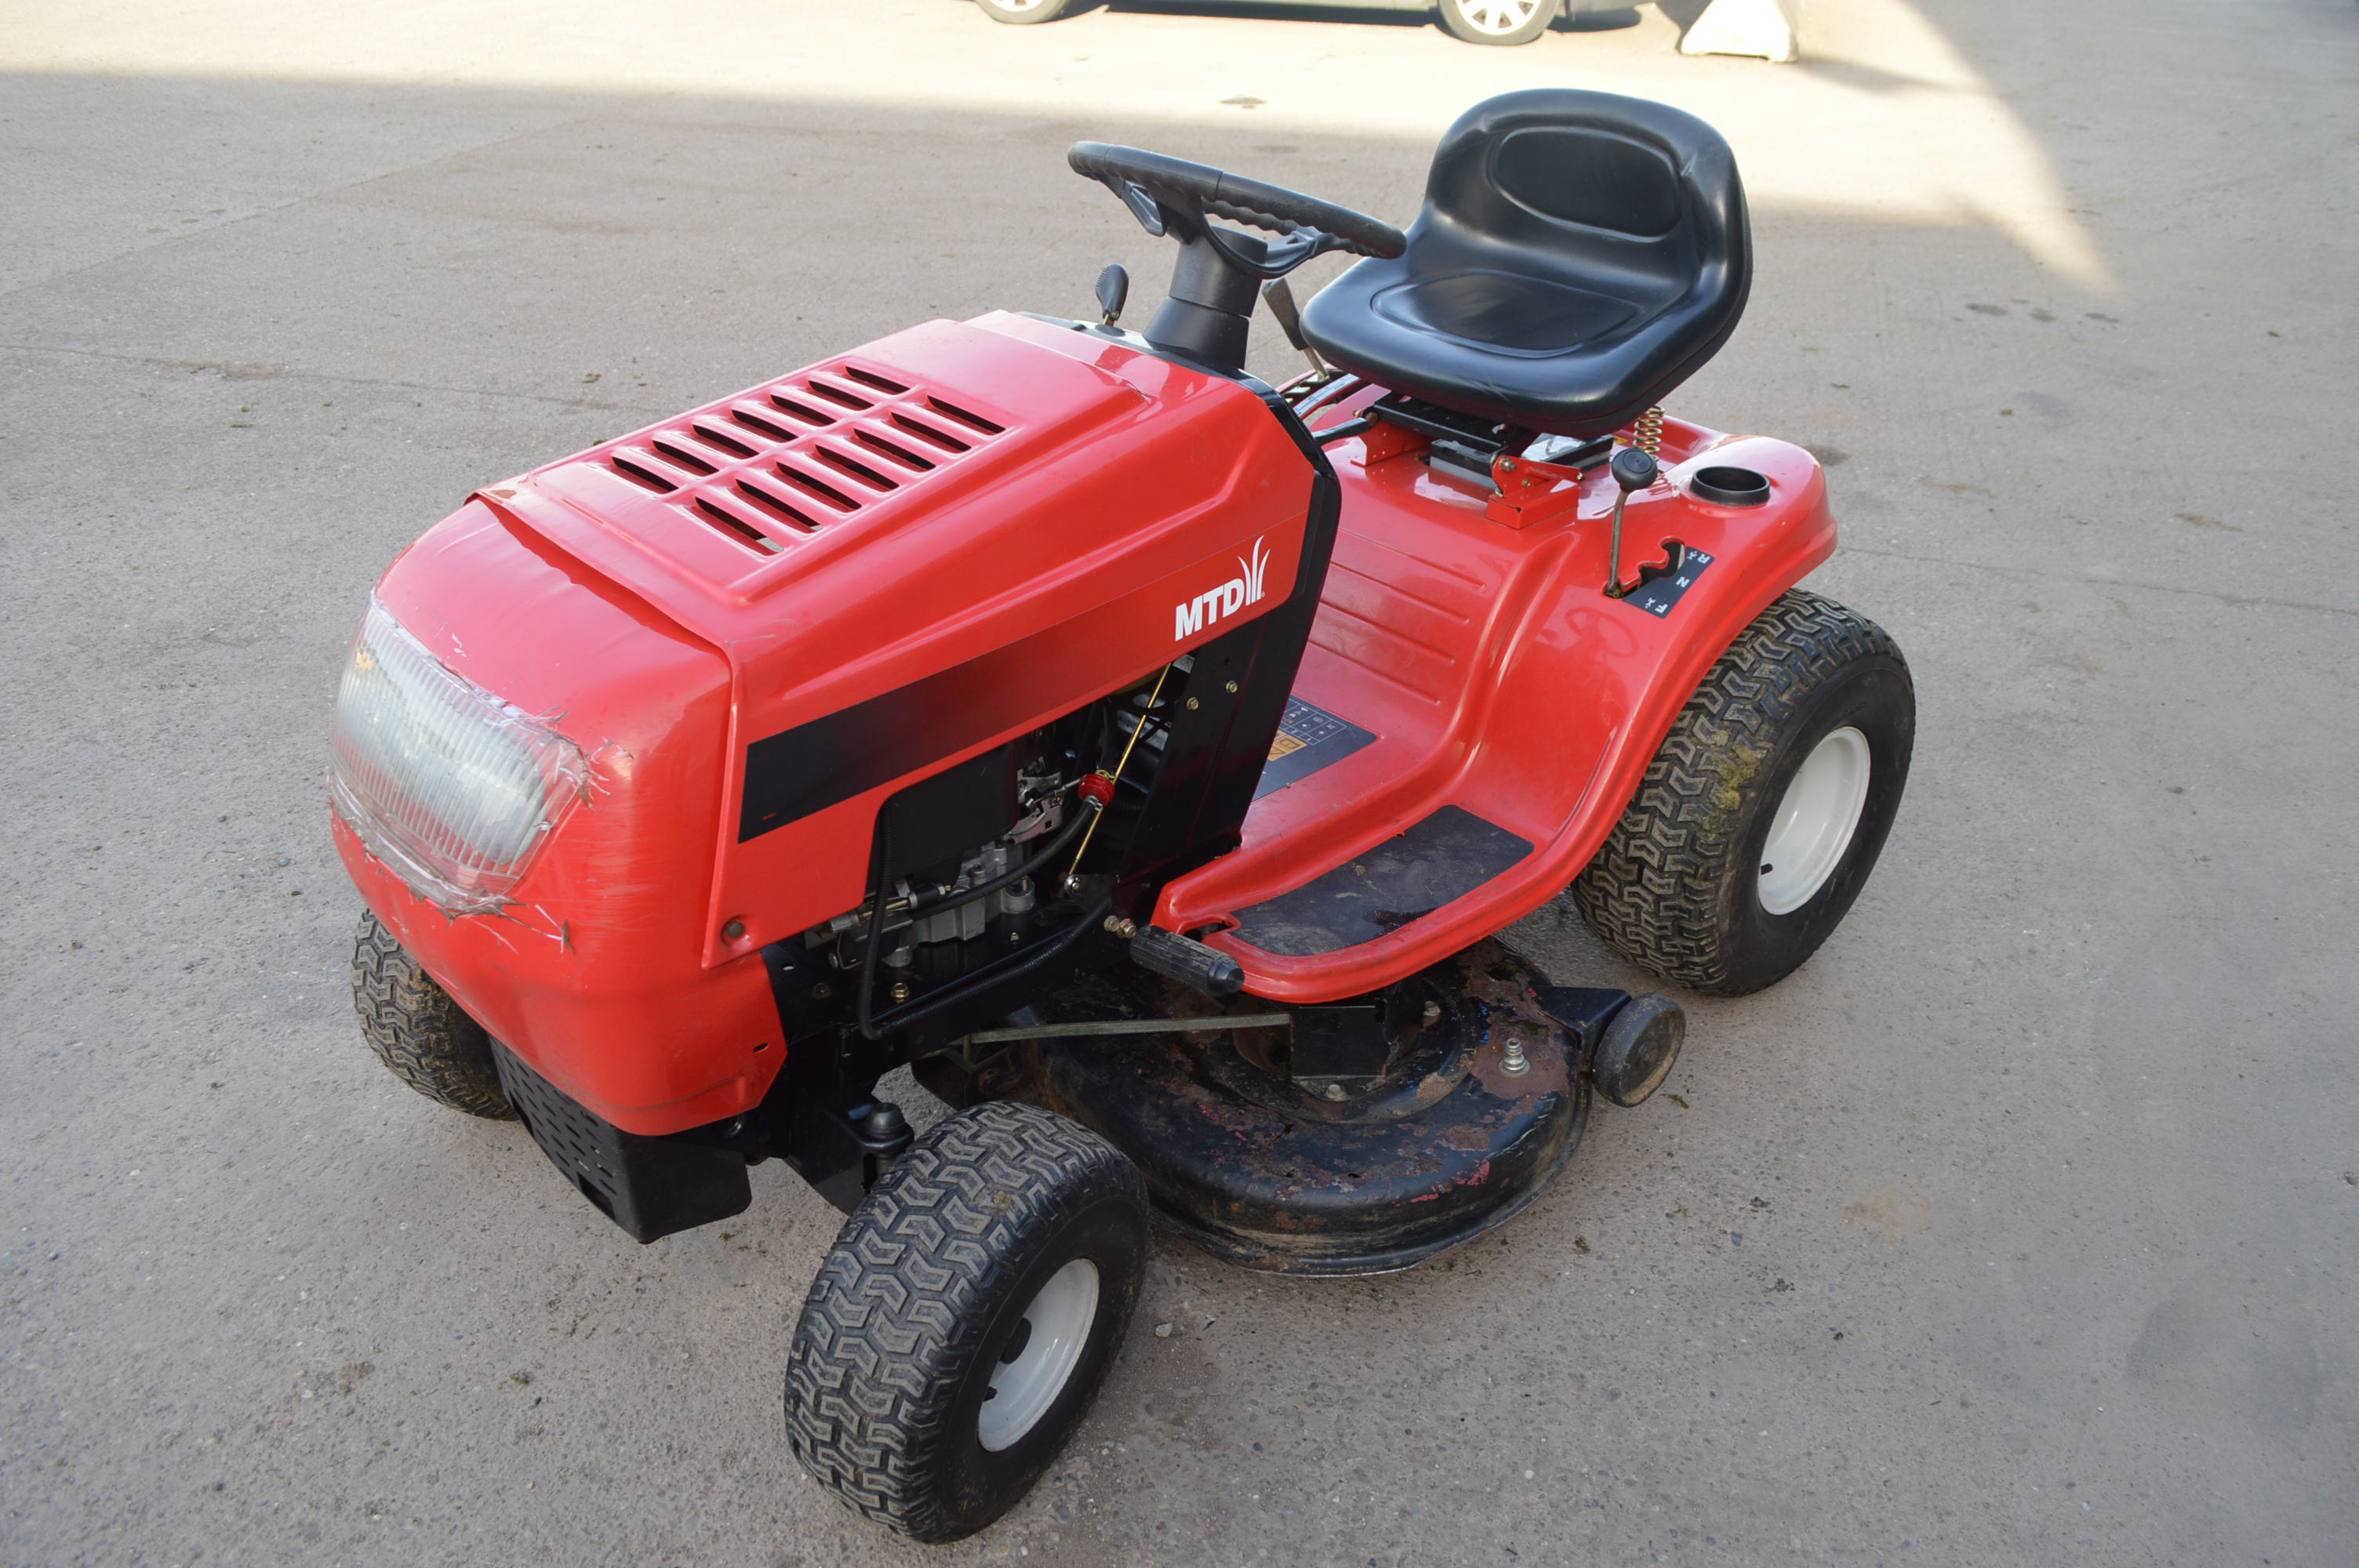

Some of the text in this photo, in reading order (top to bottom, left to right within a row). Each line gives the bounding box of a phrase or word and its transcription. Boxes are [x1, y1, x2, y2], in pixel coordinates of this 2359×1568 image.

[1697, 554, 1710, 564] R
[1676, 576, 1690, 588] N
[1175, 578, 1245, 641] MTD
[1655, 603, 1668, 613] F
